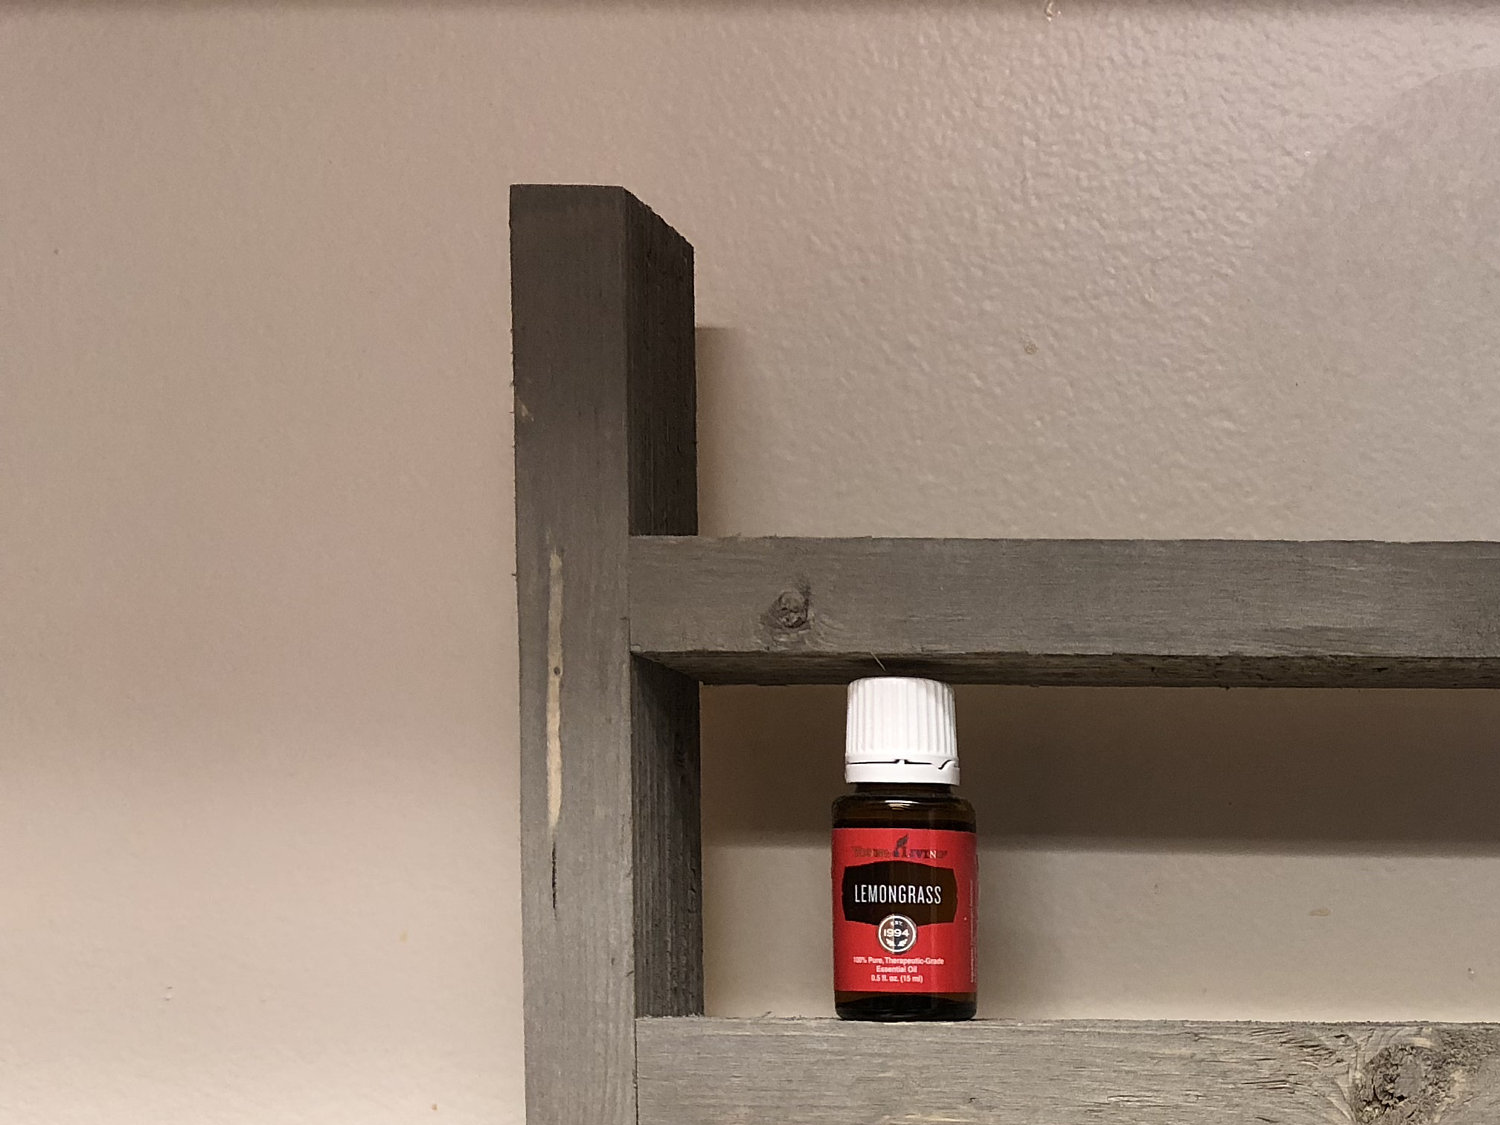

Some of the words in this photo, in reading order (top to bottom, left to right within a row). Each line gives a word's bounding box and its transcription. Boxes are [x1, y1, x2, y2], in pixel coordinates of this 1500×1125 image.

[854, 884, 942, 905] LEMONGRASS
[883, 928, 910, 938] 1994
[876, 965, 907, 973] Essential
[907, 965, 918, 973] Oil
[900, 974, 912, 983] (15
